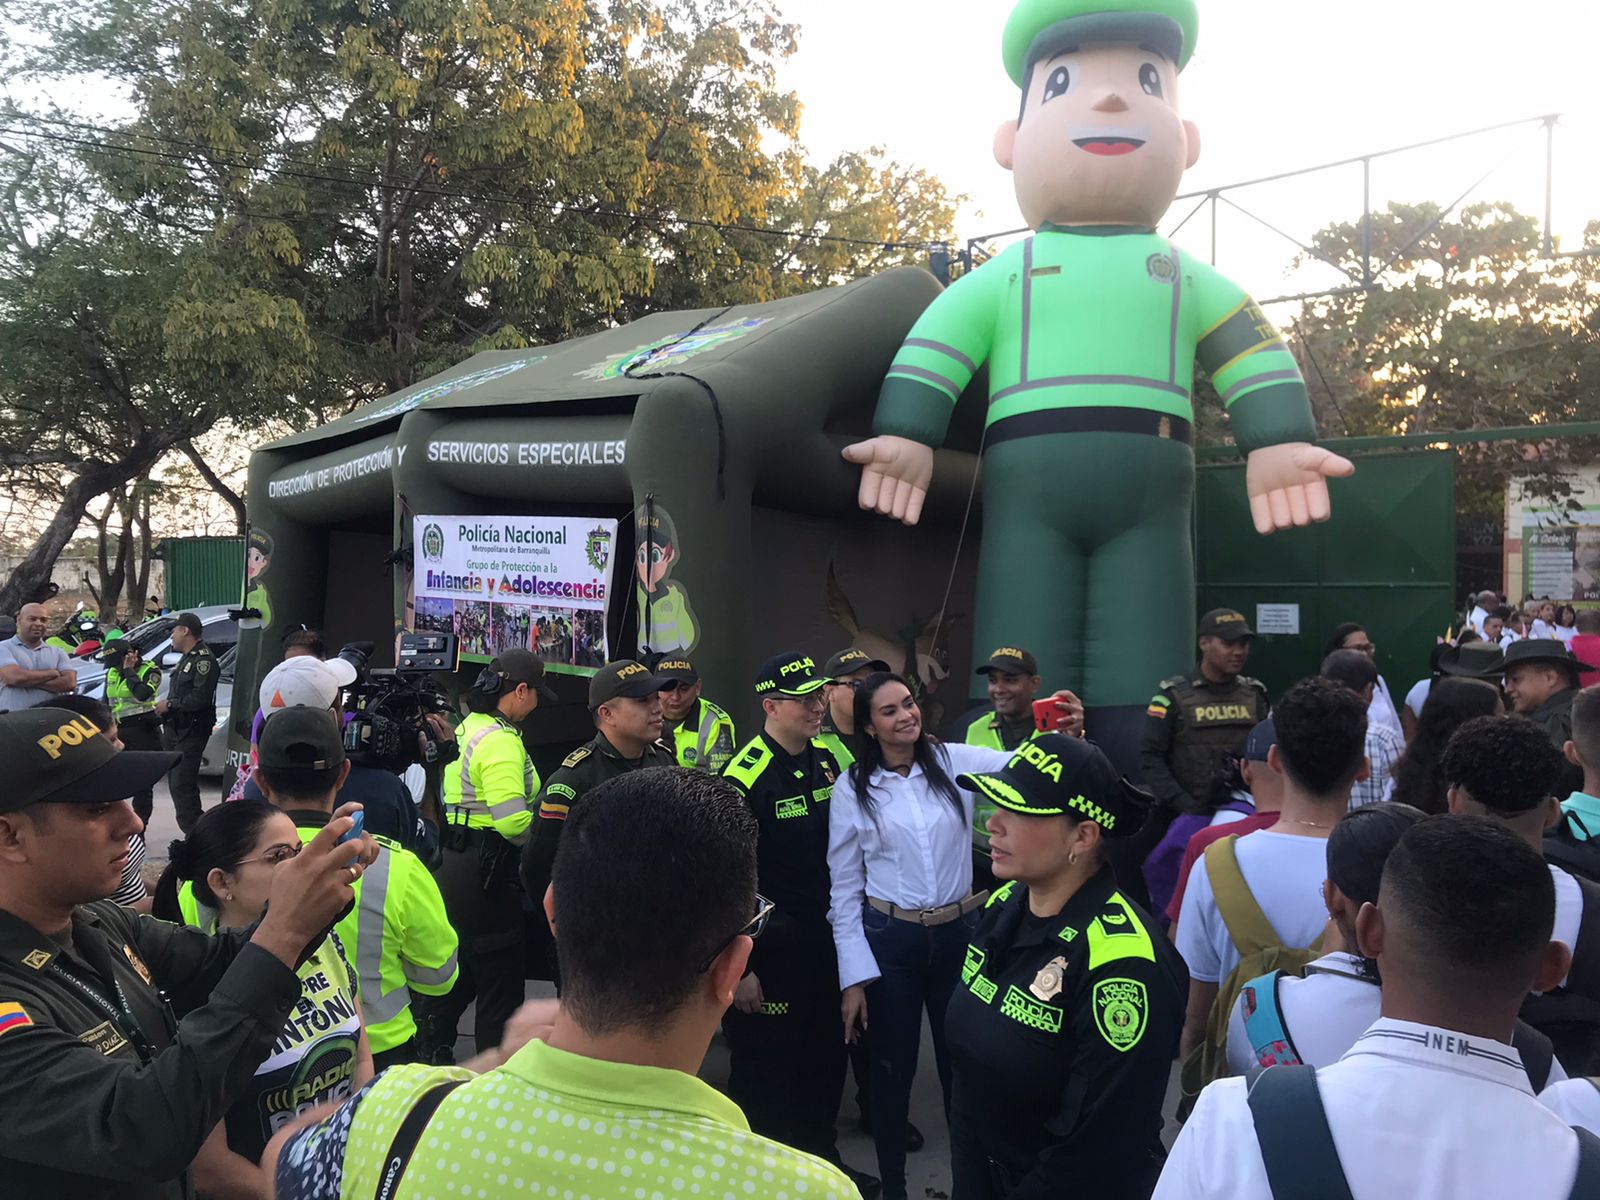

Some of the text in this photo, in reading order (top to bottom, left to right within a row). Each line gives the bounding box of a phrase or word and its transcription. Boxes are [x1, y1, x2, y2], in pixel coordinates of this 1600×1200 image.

[428, 439, 626, 465] SERVICIOS ESPECIALES
[268, 445, 407, 498] DIRECCIÓN DE PROTECCIÓN Y
[459, 524, 567, 545] Policía Nacional
[471, 544, 551, 556] Metropolitana de Barranquilla
[466, 559, 558, 573] Grupo de Protección a la
[426, 569, 606, 600] Infancia y Adolescencia
[658, 661, 692, 672] POLICIA
[1195, 704, 1250, 722] POLICIA
[1008, 991, 1055, 1025] POLICÍA
[1424, 1031, 1469, 1057] INEM
